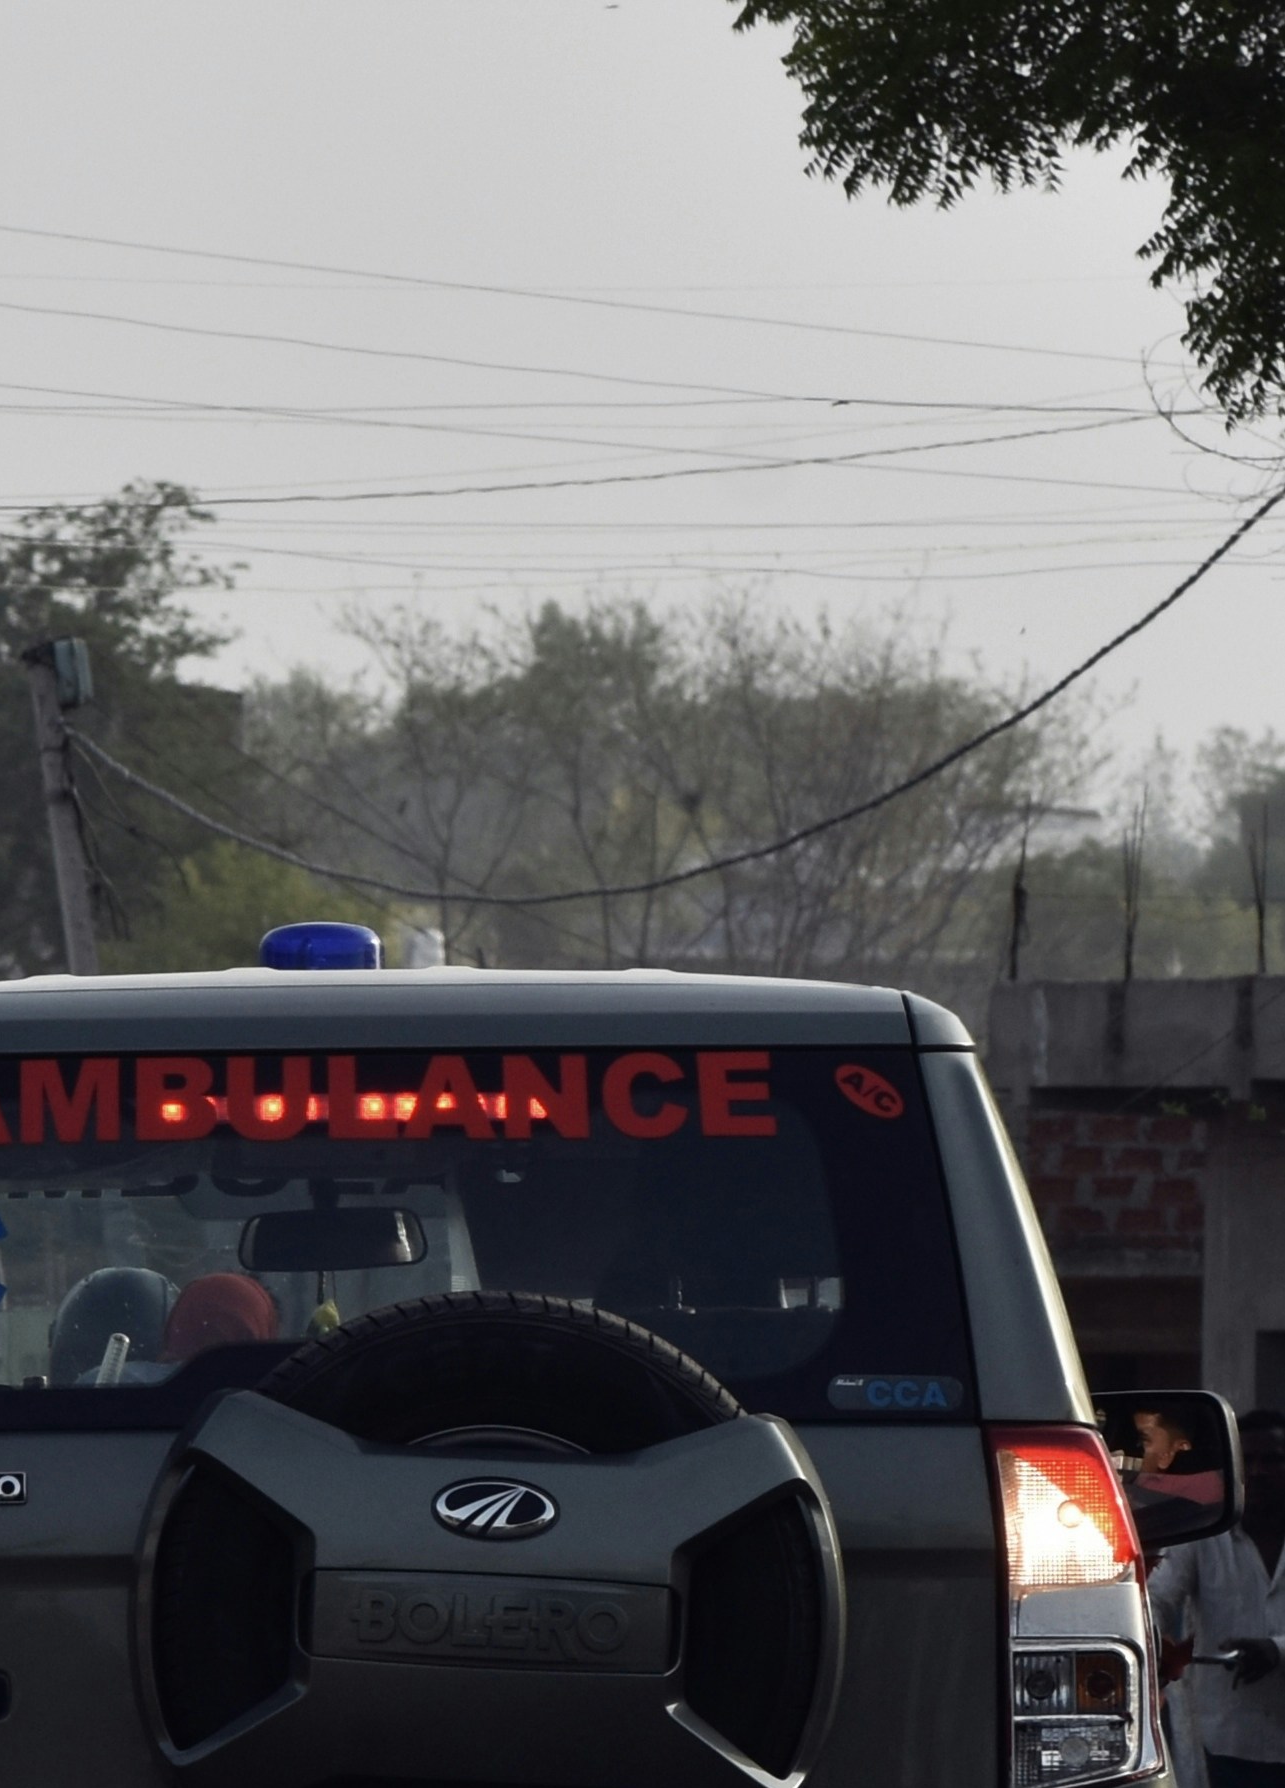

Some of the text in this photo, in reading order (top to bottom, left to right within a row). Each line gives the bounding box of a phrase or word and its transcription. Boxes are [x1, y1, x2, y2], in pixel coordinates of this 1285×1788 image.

[840, 1071, 898, 1113] A/C
[866, 1380, 948, 1408] CCA
[350, 1589, 630, 1662] BOLERO
